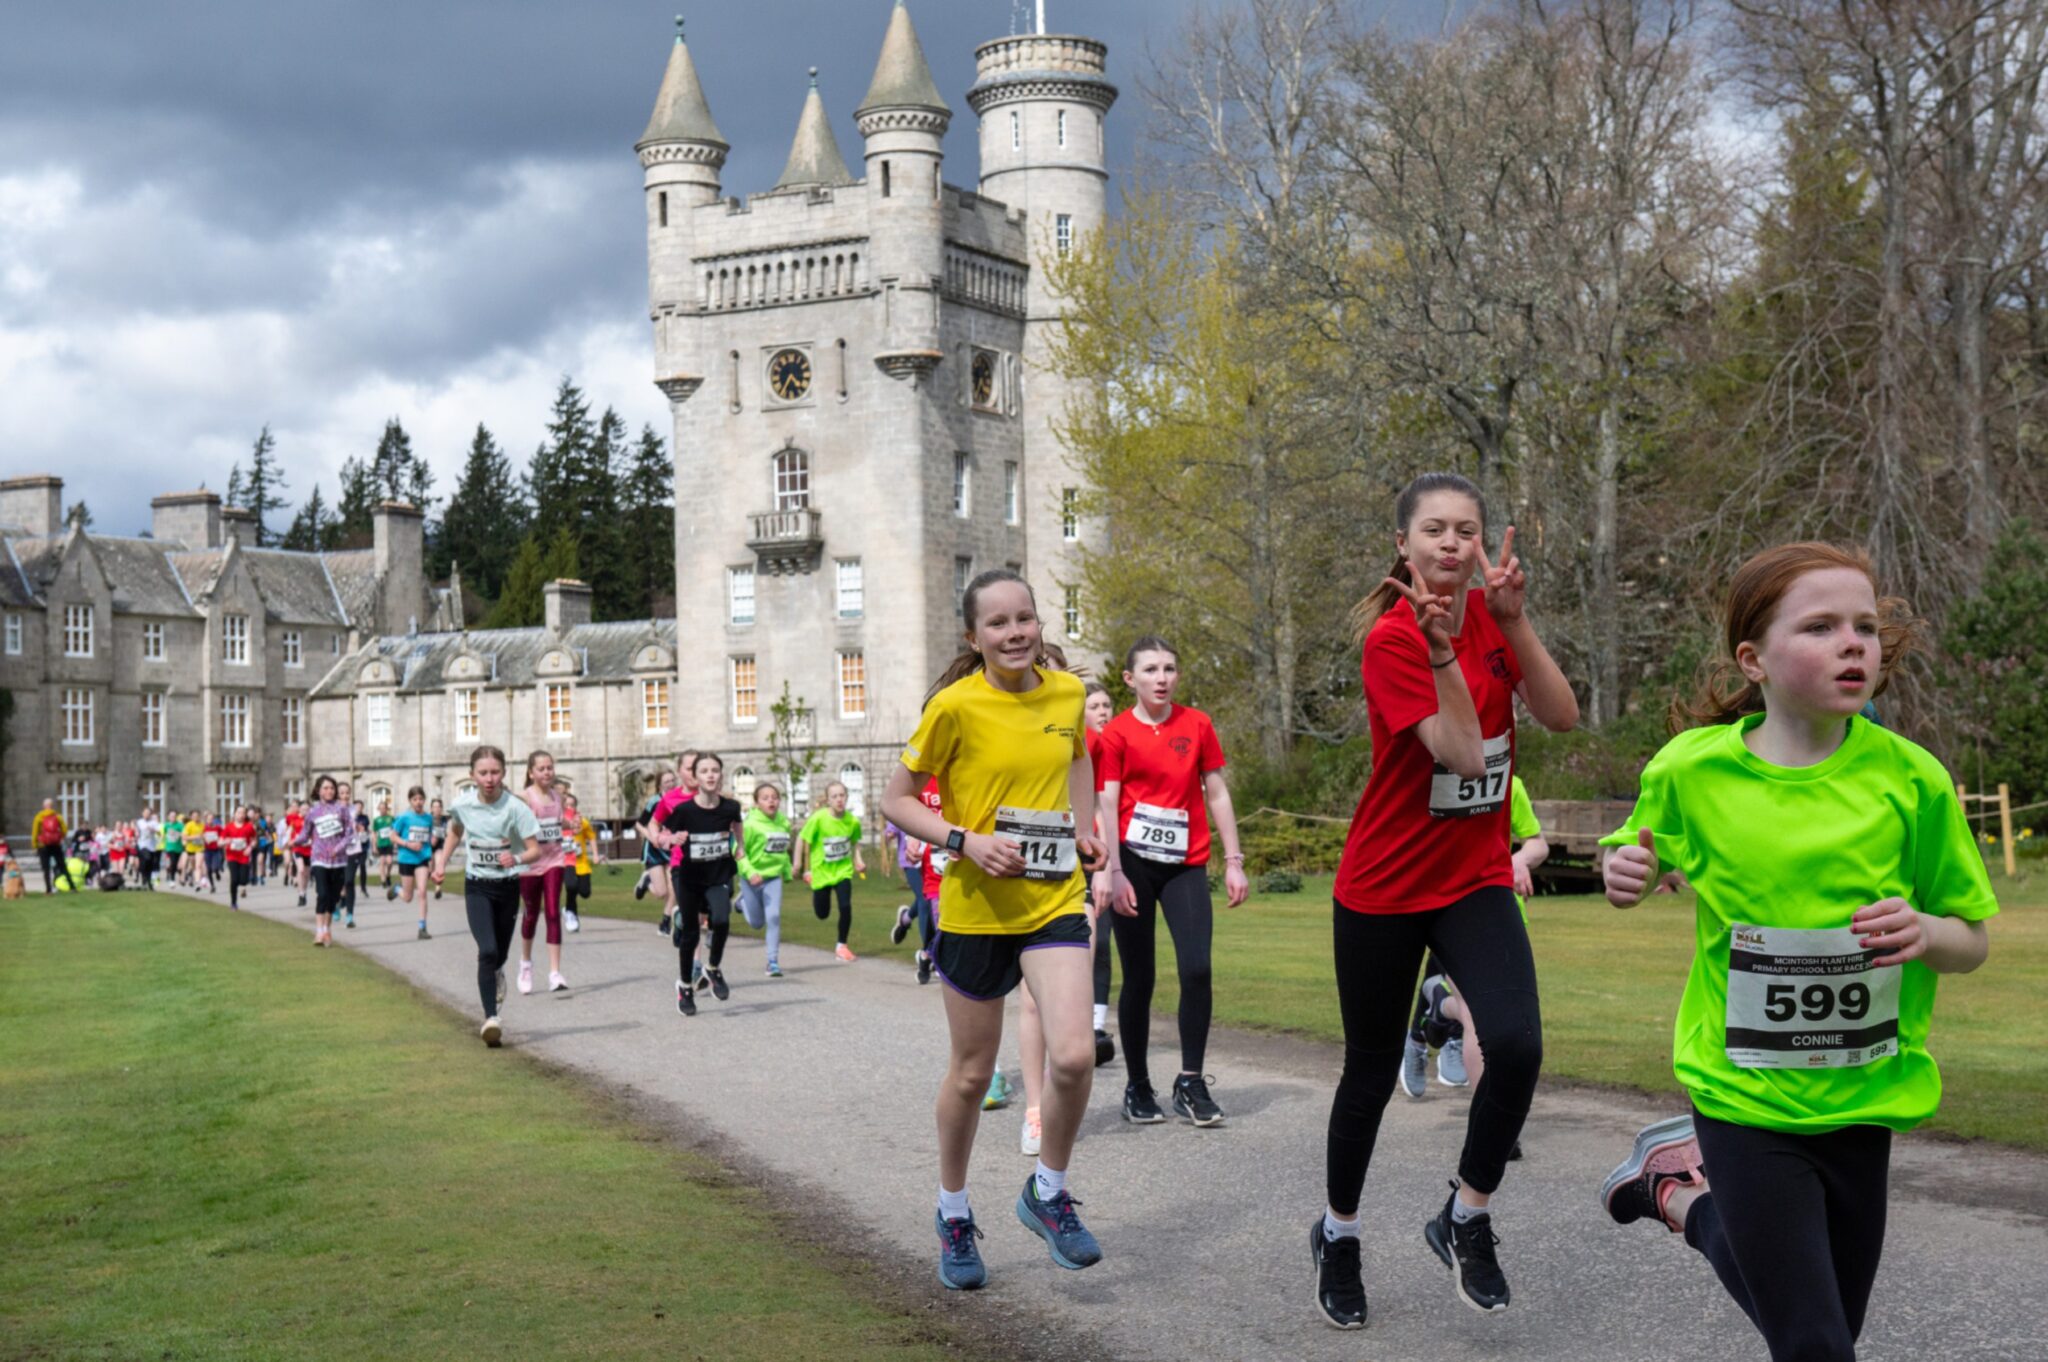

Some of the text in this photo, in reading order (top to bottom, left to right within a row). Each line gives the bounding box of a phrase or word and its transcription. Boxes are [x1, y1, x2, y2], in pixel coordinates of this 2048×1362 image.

[1458, 770, 1504, 801] 517
[1469, 805, 1491, 815] KARA
[1141, 825, 1176, 845] 789
[700, 845, 722, 856] 244
[1020, 840, 1058, 865] 114
[1024, 870, 1046, 879] ANNA
[1774, 954, 1865, 966] MCINTOSH PLANT HIRE
[1752, 963, 1789, 974] PRIMARY
[1790, 965, 1826, 974] SCHOOL
[1827, 965, 1843, 973] 1.5K
[1844, 962, 1864, 972] RACE
[1764, 981, 1871, 1022] 599
[1791, 1034, 1844, 1046] CONNIE
[1870, 1043, 1888, 1059] 599
